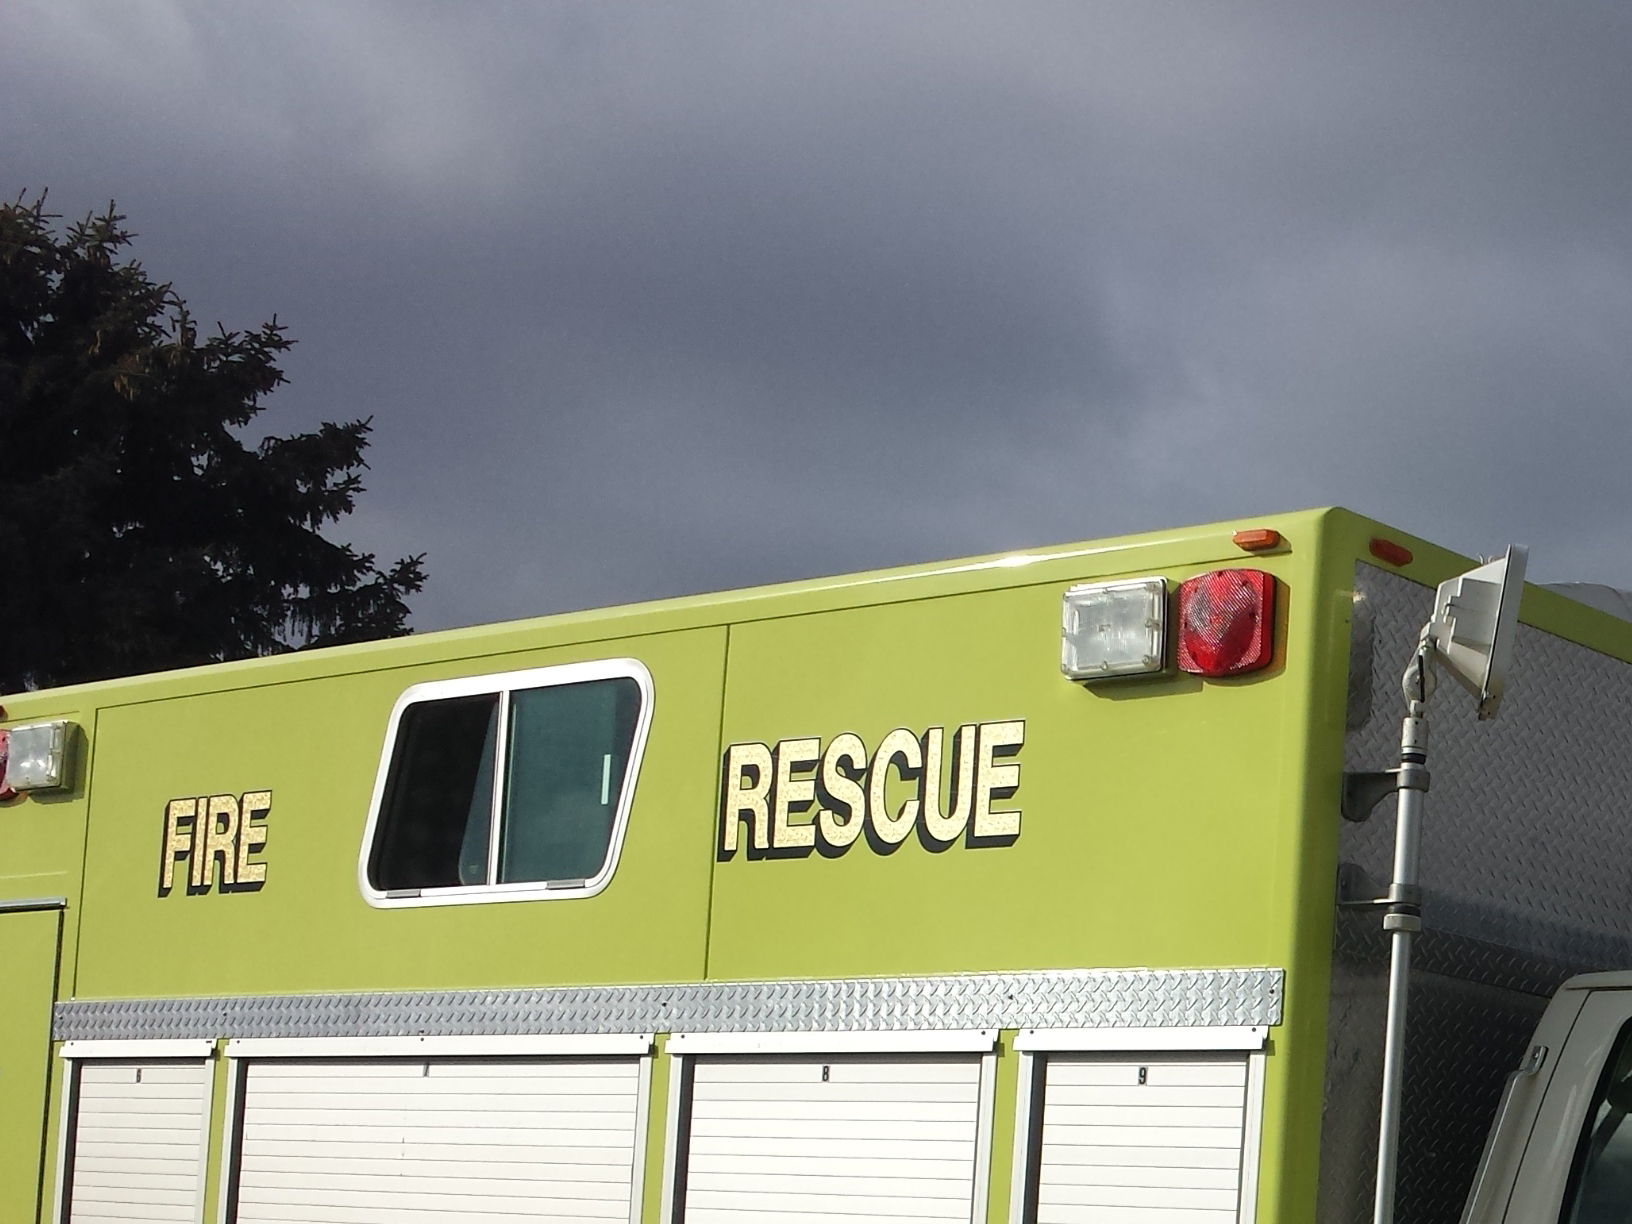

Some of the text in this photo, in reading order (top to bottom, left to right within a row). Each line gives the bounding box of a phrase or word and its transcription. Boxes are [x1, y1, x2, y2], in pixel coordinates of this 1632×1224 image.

[717, 720, 1026, 862] RESCUE
[158, 790, 273, 898] FIRE
[136, 1067, 142, 1083] 6
[822, 1065, 830, 1082] 8
[1139, 1066, 1147, 1085] 9
